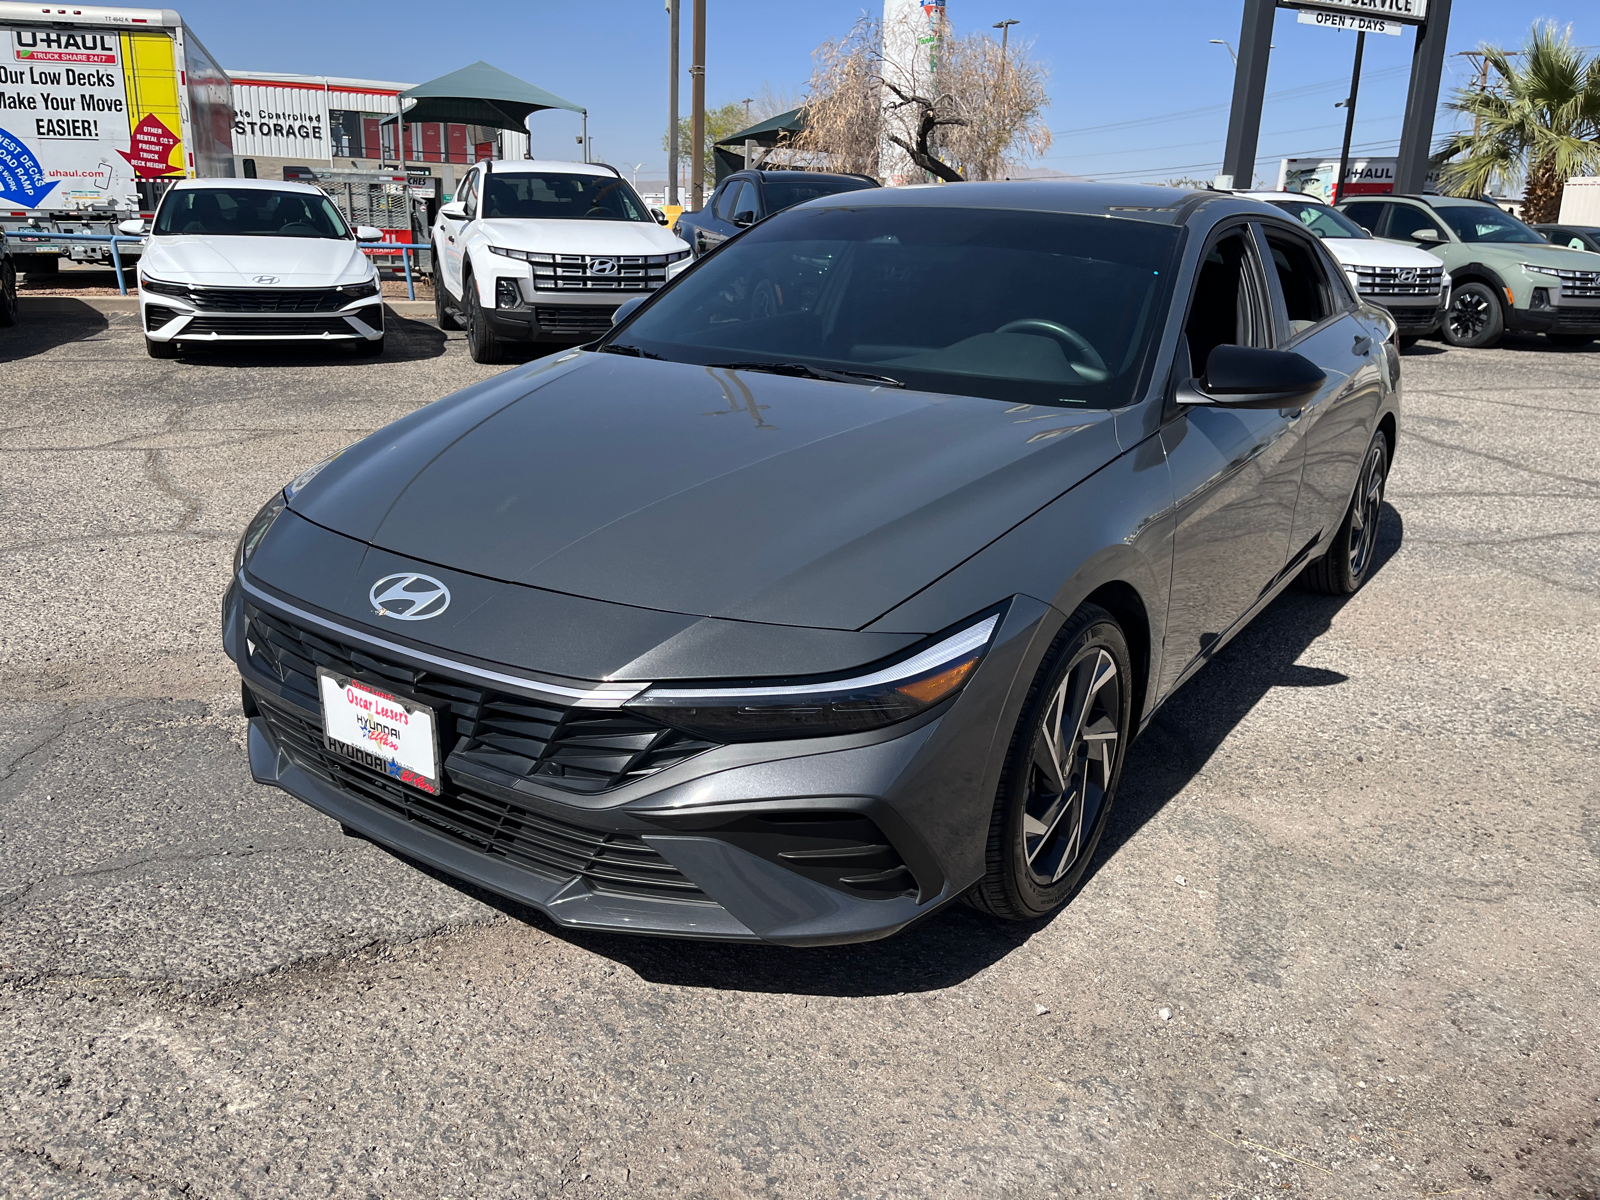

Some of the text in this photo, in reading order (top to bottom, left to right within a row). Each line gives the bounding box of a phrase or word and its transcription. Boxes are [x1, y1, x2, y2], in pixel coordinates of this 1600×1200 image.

[1316, 12, 1386, 32] OPEN 7 DAYS
[33, 52, 60, 60] TRUCK
[61, 53, 88, 61] SHARE
[0, 66, 115, 87] Our Low Decks
[40, 93, 76, 111] Your
[80, 94, 123, 112] Move
[259, 109, 321, 123] Controlled
[35, 118, 99, 137] EASIER!
[143, 126, 163, 135] OTHER
[235, 120, 323, 141] STORAGE
[136, 134, 159, 143] RENTAL
[138, 143, 163, 152] FREIGHT
[131, 159, 167, 170] DECK HEIGHT
[140, 152, 159, 160] TRUCK
[20, 154, 43, 187] DECKS
[48, 170, 105, 178] uhaul.com
[15, 167, 34, 196] RAMP
[351, 679, 371, 693] Oscar
[346, 688, 409, 725] Oscar Leeser's
[356, 713, 401, 741] HYUNDAI
[328, 736, 388, 774] HYUNDAI
